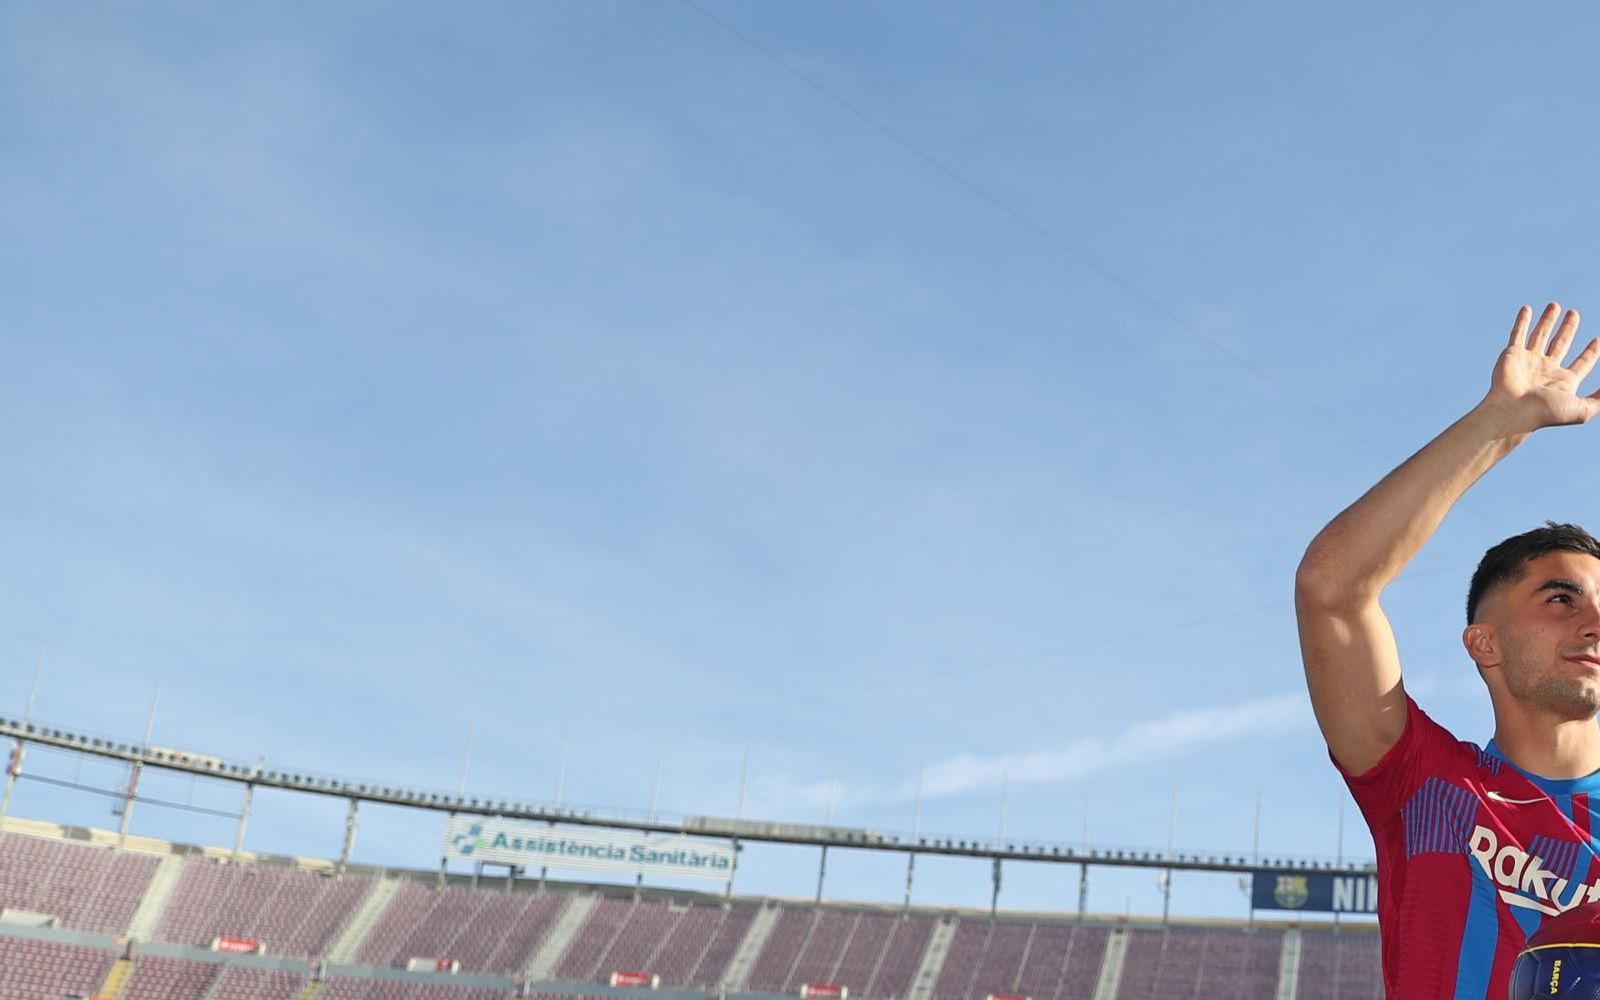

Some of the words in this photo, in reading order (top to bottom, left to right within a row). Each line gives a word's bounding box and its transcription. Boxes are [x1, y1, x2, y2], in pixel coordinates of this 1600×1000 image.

[491, 832, 625, 860] Assistència
[629, 844, 729, 870] Sanitària
[1550, 959, 1562, 995] BARÇA
